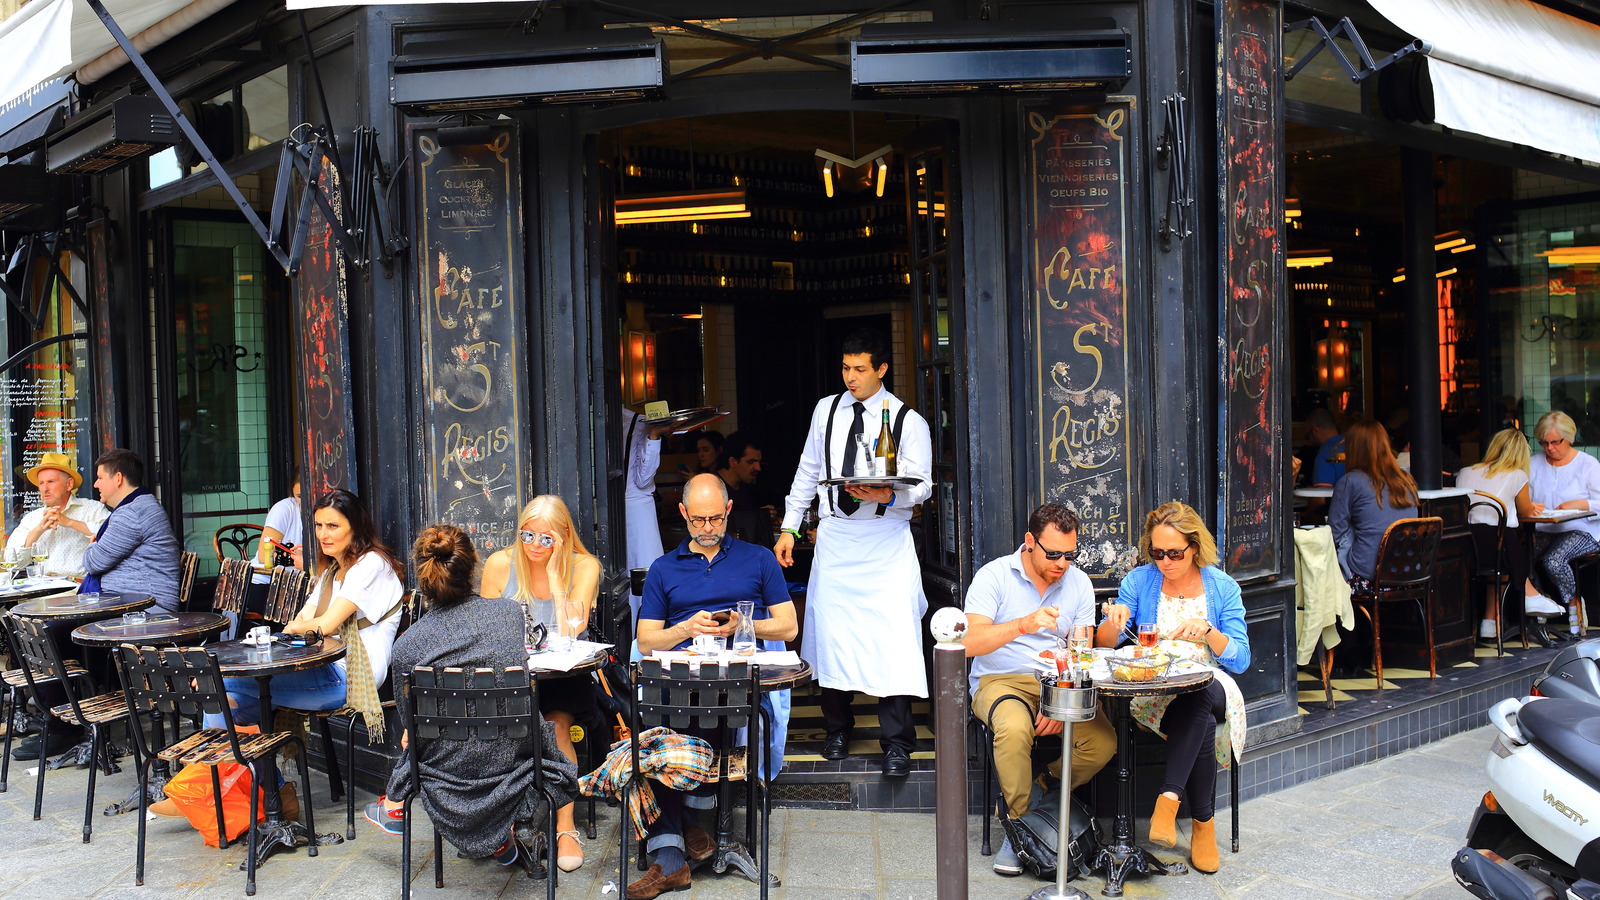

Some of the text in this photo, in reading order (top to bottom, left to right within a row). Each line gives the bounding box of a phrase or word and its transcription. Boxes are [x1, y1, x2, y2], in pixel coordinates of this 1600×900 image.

[1240, 65, 1258, 78] RUE
[1244, 81, 1269, 96] LOUIS
[1233, 95, 1245, 106] EN
[1039, 173, 1119, 183] VIENNOISERIES
[1050, 187, 1109, 198] OEUFS BIO
[441, 210, 493, 219] LIMONADE
[1049, 405, 1120, 468] REGIS
[441, 422, 509, 484] REGIS
[1109, 505, 1120, 515] ET
[503, 521, 514, 530] EN
[1079, 522, 1126, 537] KFAST
